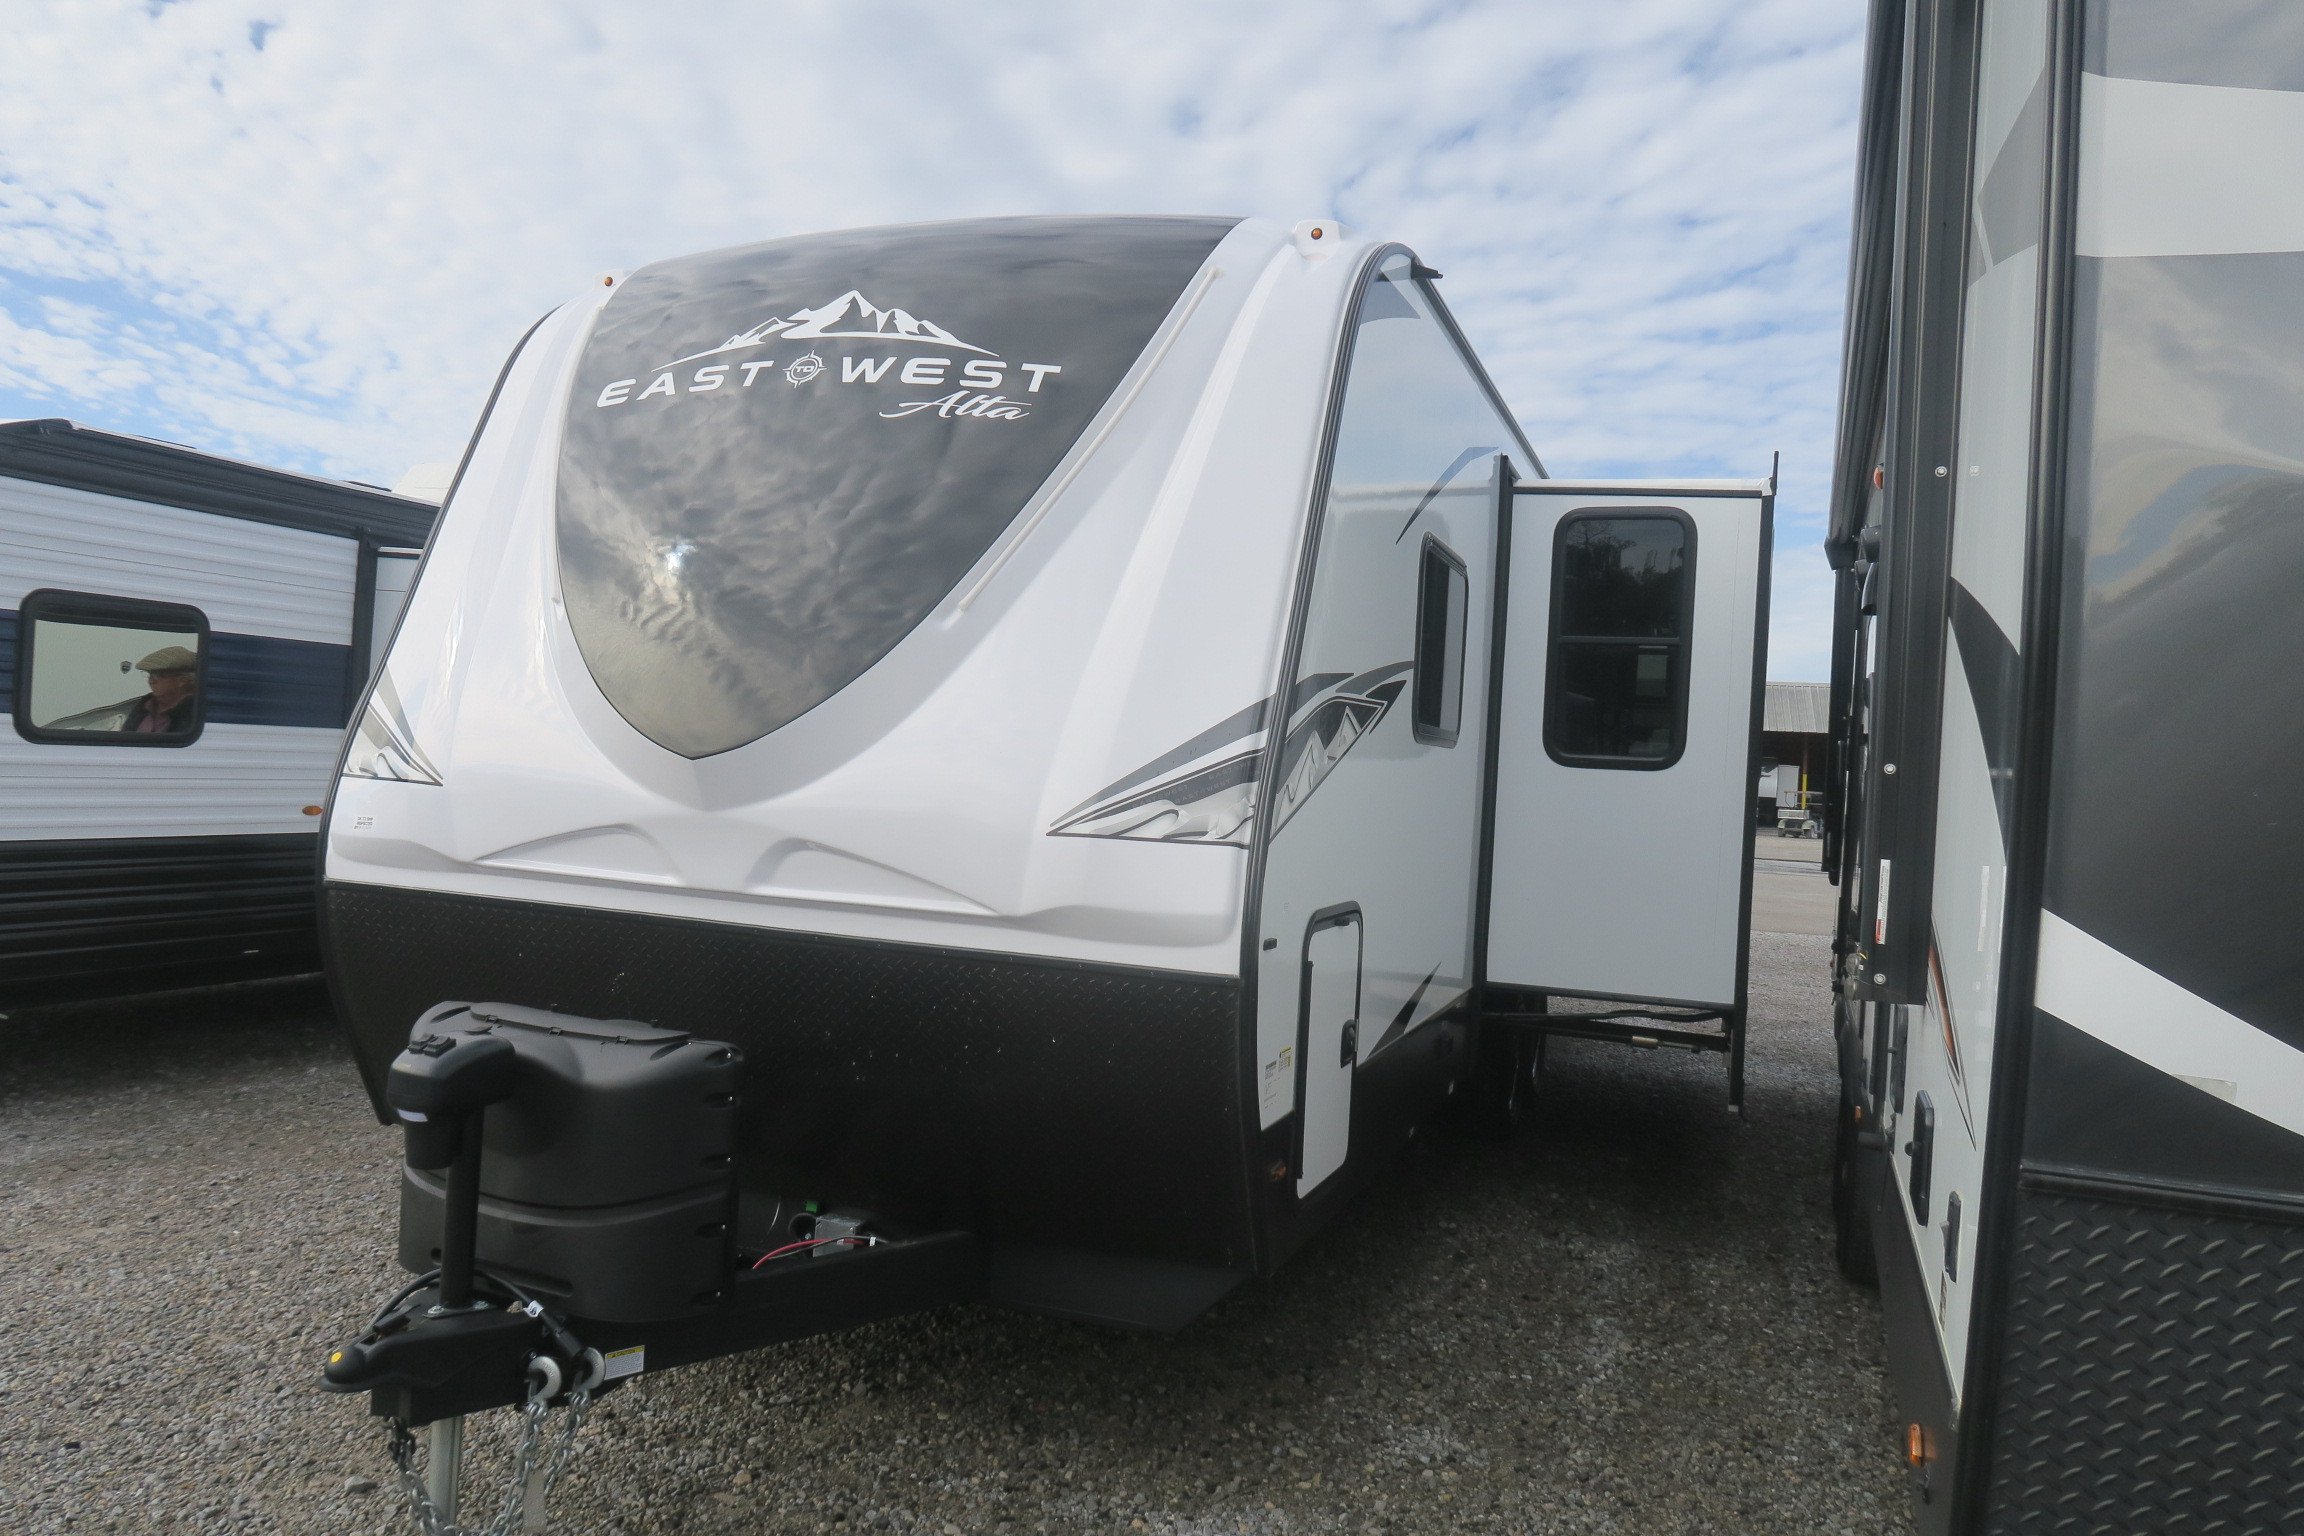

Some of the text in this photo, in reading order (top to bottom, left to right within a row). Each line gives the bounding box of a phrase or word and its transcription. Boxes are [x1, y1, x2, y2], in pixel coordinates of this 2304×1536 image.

[596, 356, 1062, 408] EAST TO WEST
[878, 389, 1033, 421] Alta
